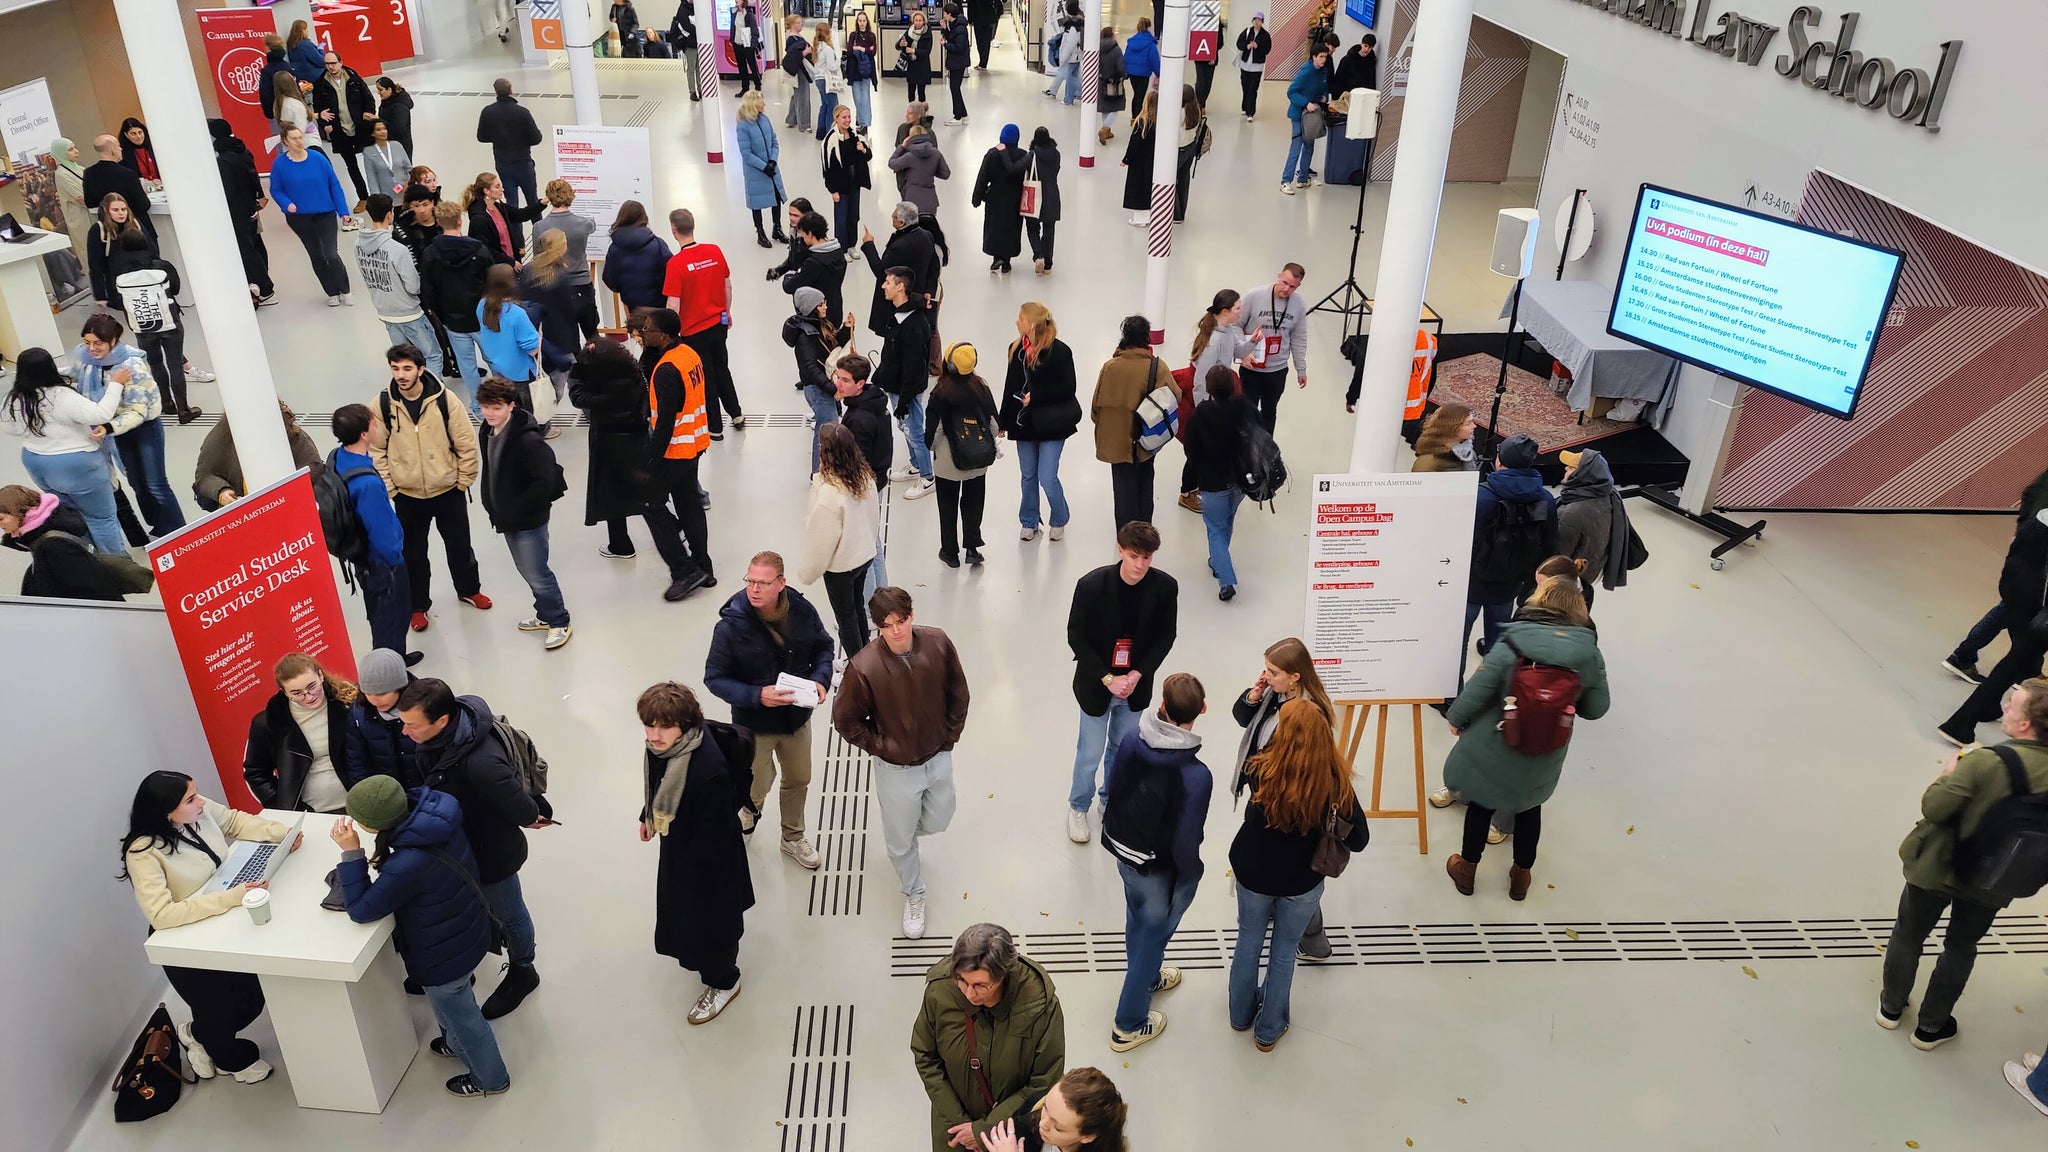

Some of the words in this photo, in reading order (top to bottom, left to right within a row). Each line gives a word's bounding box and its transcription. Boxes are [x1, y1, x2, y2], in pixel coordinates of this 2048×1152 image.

[390, 0, 405, 26] 3
[206, 31, 245, 41] Campus
[356, 14, 373, 41] 2
[541, 25, 556, 44] C
[1195, 38, 1210, 55] A
[1685, 0, 1779, 66] Law
[1775, 6, 1963, 133] School
[7, 112, 27, 126] Central
[10, 122, 34, 136] Diversity
[33, 116, 49, 127] Office
[1762, 191, 1790, 214] A3-A10
[1647, 218, 1666, 233] UvA
[1667, 225, 1705, 244] podium
[1706, 235, 1720, 248] (in
[1721, 240, 1745, 255] deze
[1746, 246, 1768, 263] hal)
[1640, 247, 1658, 257] 14.30
[1665, 254, 1678, 263] Rad
[1678, 259, 1690, 267] van
[1691, 262, 1715, 275] Fortuin
[1720, 272, 1742, 284] Wheel
[1750, 280, 1779, 294] Fortune
[1637, 260, 1654, 270] 15.15
[1660, 267, 1704, 286] Amsterdamse
[1705, 281, 1783, 311] studentenverenigingen
[132, 298, 145, 321] FACE
[140, 289, 153, 321] NORTH
[150, 302, 162, 319] THE
[1631, 285, 1648, 296] 16.45
[1655, 292, 1668, 302] Rad
[1668, 298, 1680, 306] van
[1680, 301, 1704, 314] Fortuin
[1709, 310, 1730, 323] Wheel
[1730, 317, 1739, 325] of
[1739, 320, 1767, 335] Fortune
[1634, 272, 1652, 283] 16.00
[1658, 280, 1675, 291] Grote
[1675, 285, 1706, 300] Studenten
[1707, 296, 1739, 312] Stereotype
[1740, 306, 1754, 317] Test
[1758, 312, 1776, 324] Great
[1777, 318, 1803, 333] Student
[1804, 327, 1841, 345] Stereotype
[1842, 339, 1858, 350] Test
[1624, 311, 1641, 321] 18.15
[1647, 319, 1690, 339] Amsterdamse
[1691, 335, 1767, 365] studentenverenigingen
[1628, 297, 1645, 308] 17.30
[1651, 305, 1668, 316] Grote
[1668, 311, 1698, 326] Studenten
[1698, 322, 1731, 338] Stereotype
[1732, 333, 1746, 343] Test
[1750, 339, 1768, 350] Great
[1769, 345, 1795, 359] Student
[1795, 354, 1832, 372] Stereotype
[1832, 367, 1847, 377] Test
[1318, 514, 1341, 524] Open
[1342, 514, 1375, 524] Campus
[1376, 513, 1392, 523] Dag
[1319, 504, 1352, 513] Welkom
[1352, 506, 1364, 514] op
[1364, 504, 1375, 512] de
[173, 526, 226, 557] UNIVERSITEIT
[226, 518, 242, 530] VAN
[242, 497, 287, 523] AMSTERDAM
[180, 565, 249, 614] Central
[250, 531, 316, 577] Student
[200, 584, 266, 630] Service
[266, 558, 311, 593] Desk
[289, 601, 303, 614] Ask
[303, 597, 313, 606] us
[291, 605, 315, 623] about:
[297, 624, 321, 641] Admission
[299, 635, 315, 648] Tuition
[314, 630, 324, 639] fees
[204, 653, 220, 665] Stel
[221, 641, 237, 655] hier
[237, 633, 247, 646] al
[245, 631, 254, 642] je
[209, 653, 236, 673] vragen
[236, 641, 256, 656] over:
[216, 670, 244, 691] Collegegeld
[243, 660, 262, 675] betalen
[222, 657, 252, 678] Inschrijving
[227, 672, 256, 693] Huisvesting
[238, 678, 261, 698] Matching
